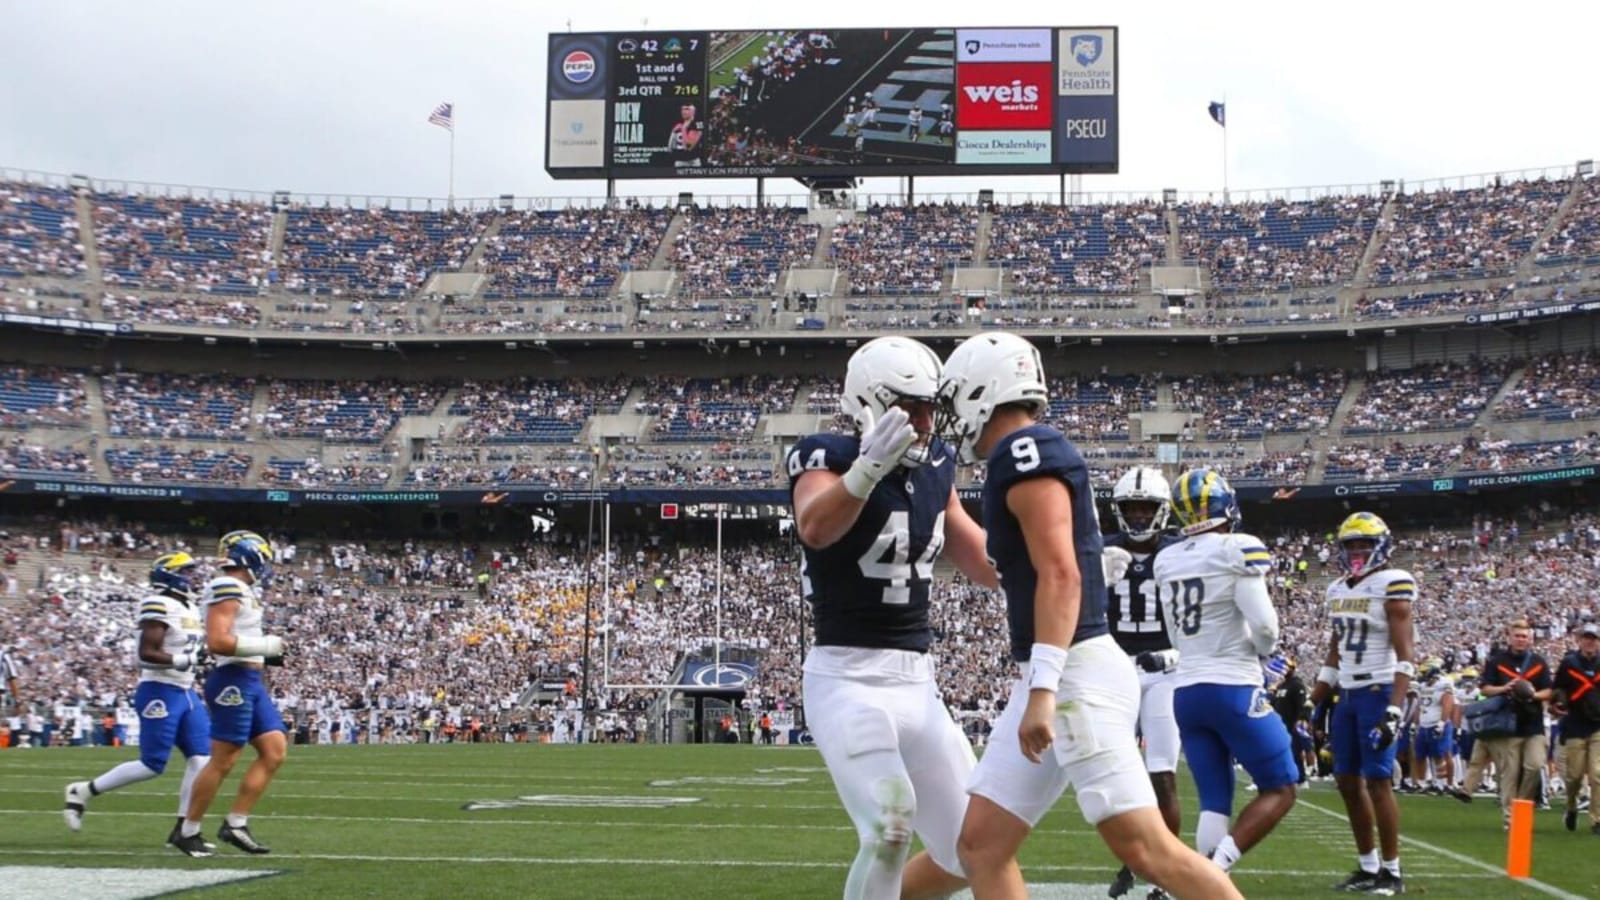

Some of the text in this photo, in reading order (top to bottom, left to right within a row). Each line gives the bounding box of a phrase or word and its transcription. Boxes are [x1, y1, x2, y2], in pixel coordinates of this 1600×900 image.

[641, 40, 658, 51] 42
[690, 40, 698, 51] 7
[636, 63, 684, 73] 1st and 6
[674, 85, 699, 95] 7:16
[1062, 79, 1111, 89] Health
[618, 86, 662, 96] 3rd QTR
[963, 79, 1038, 103] weis
[615, 102, 641, 122] DREW
[614, 124, 644, 144] ALLAR
[1067, 119, 1106, 138] PSECU
[957, 139, 1047, 152] Ciocca Dealerships
[676, 167, 706, 175] NITTANY
[708, 167, 726, 175] LION
[1011, 436, 1041, 473] 9
[1468, 467, 1595, 486] PSECU.COM/PENNSTATESPORTS
[64, 483, 107, 494] SEASON
[110, 486, 166, 496] PRESENTED
[305, 492, 439, 502] PSECU.COM/PENNSTATESPORTS
[685, 505, 698, 517] 42
[857, 510, 946, 604] 44
[1114, 578, 1162, 633] 11
[1170, 577, 1204, 637] 18
